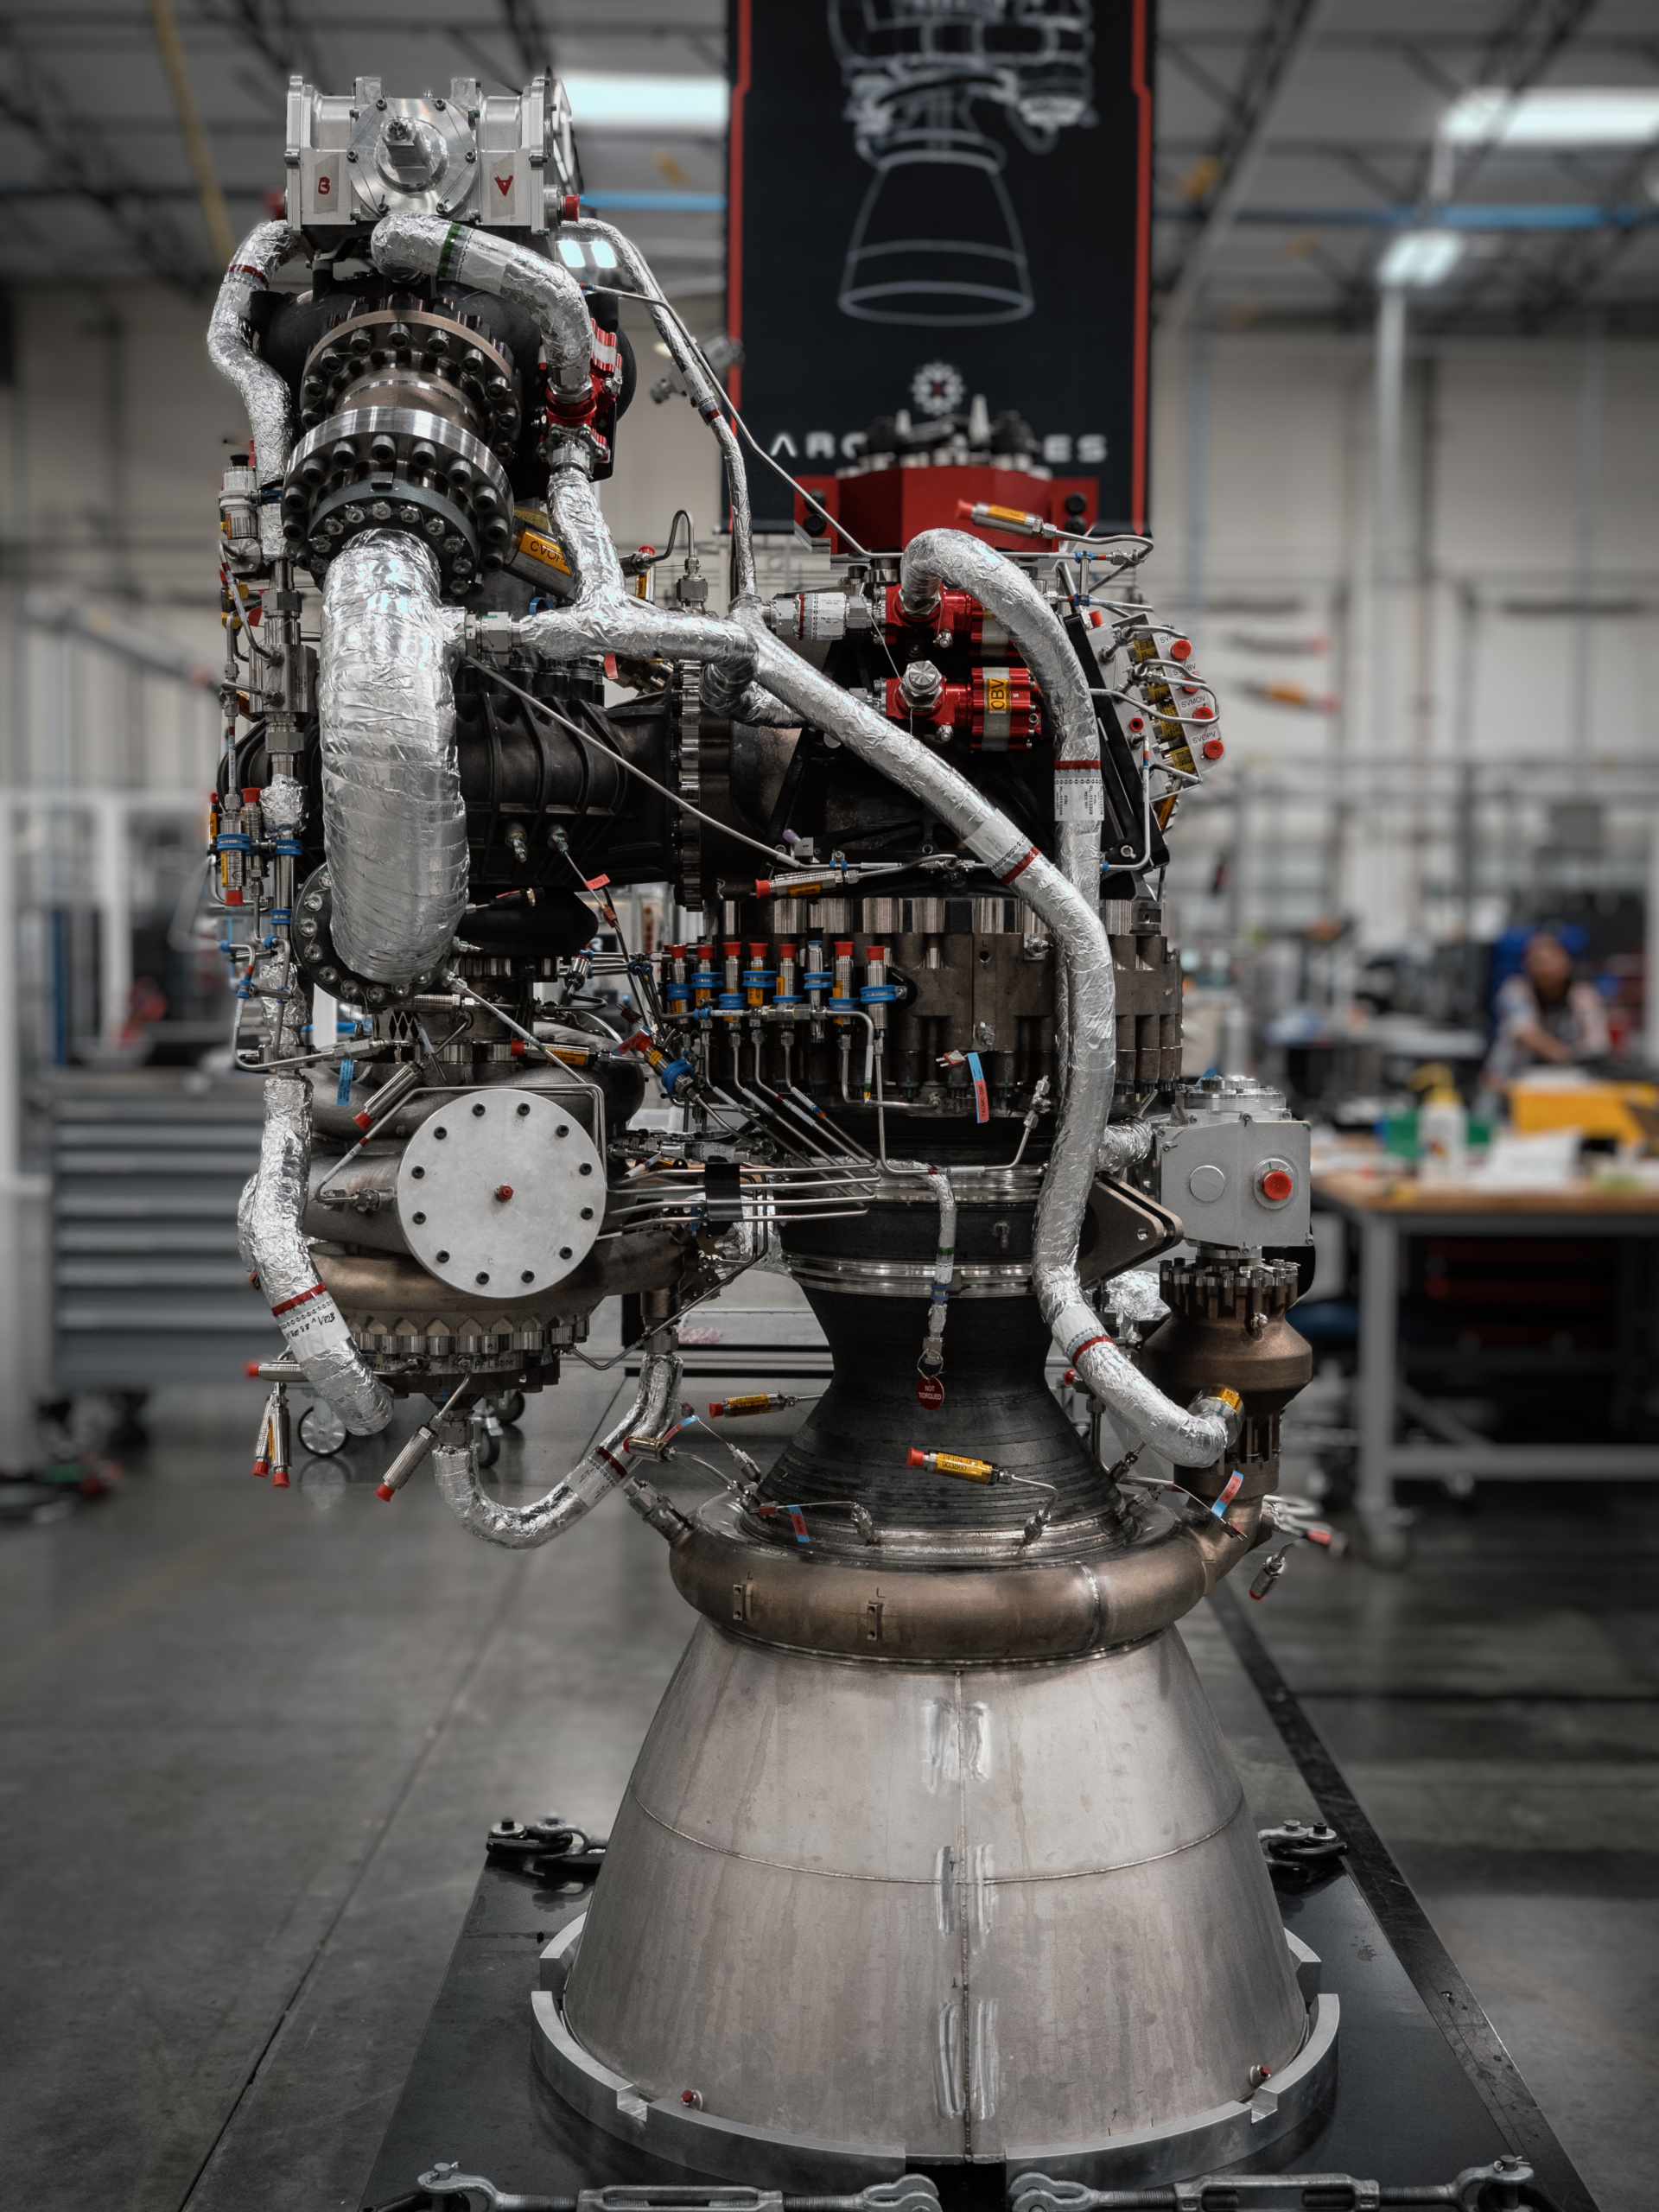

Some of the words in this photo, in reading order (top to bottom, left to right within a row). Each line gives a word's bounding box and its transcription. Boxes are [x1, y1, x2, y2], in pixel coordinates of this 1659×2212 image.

[318, 176, 330, 194] B
[494, 175, 513, 196] A
[991, 679, 1005, 709] OBV
[1181, 695, 1206, 708] SVMOV
[1192, 731, 1216, 744] SVOPV
